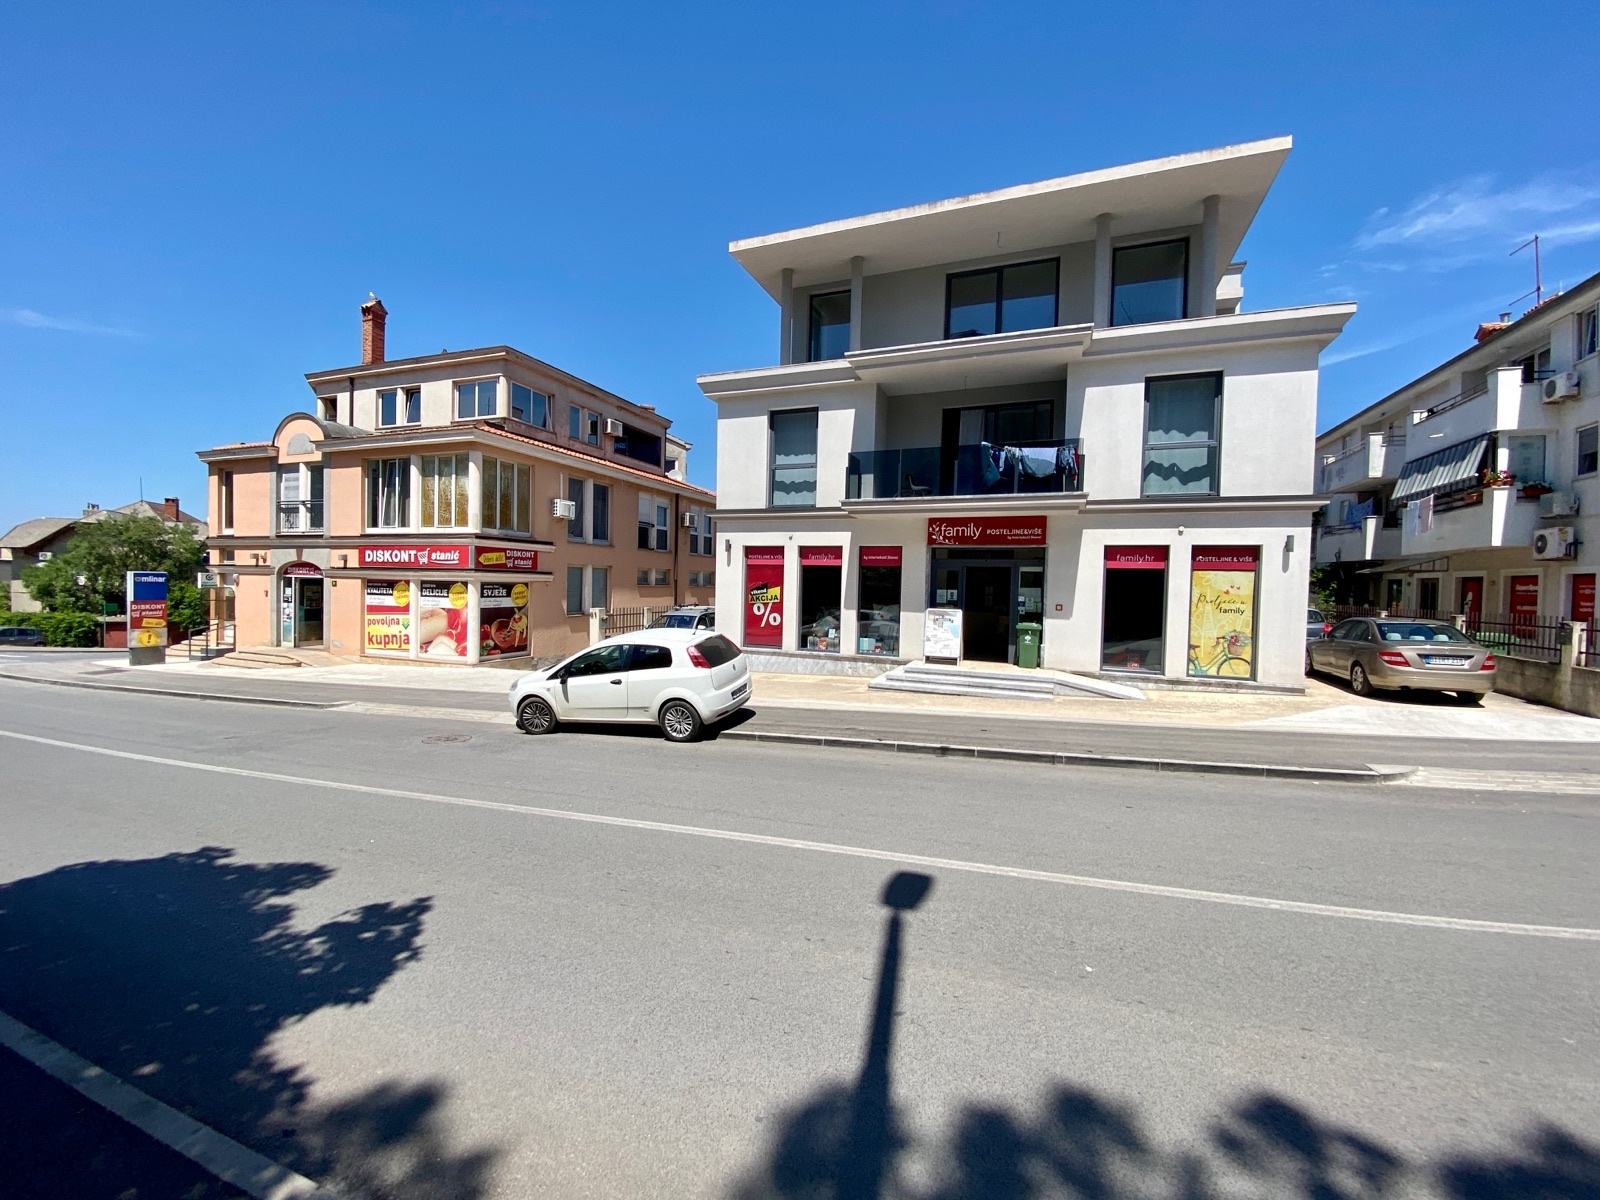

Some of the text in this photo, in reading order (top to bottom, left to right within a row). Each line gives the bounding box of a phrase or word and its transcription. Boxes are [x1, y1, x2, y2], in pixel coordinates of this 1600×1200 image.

[941, 522, 982, 540] family
[365, 549, 460, 563] DISKONT stanić
[506, 550, 535, 558] DISKONT
[1116, 554, 1155, 564] family.hr
[141, 575, 166, 583] mlinar
[422, 588, 449, 596] DELICIJE
[483, 587, 507, 596] SVJEŽE
[750, 594, 779, 602] AKCIJA
[752, 601, 781, 628] %
[1219, 607, 1245, 615] family
[367, 616, 400, 627] povoljna
[367, 630, 410, 648] kupnja
